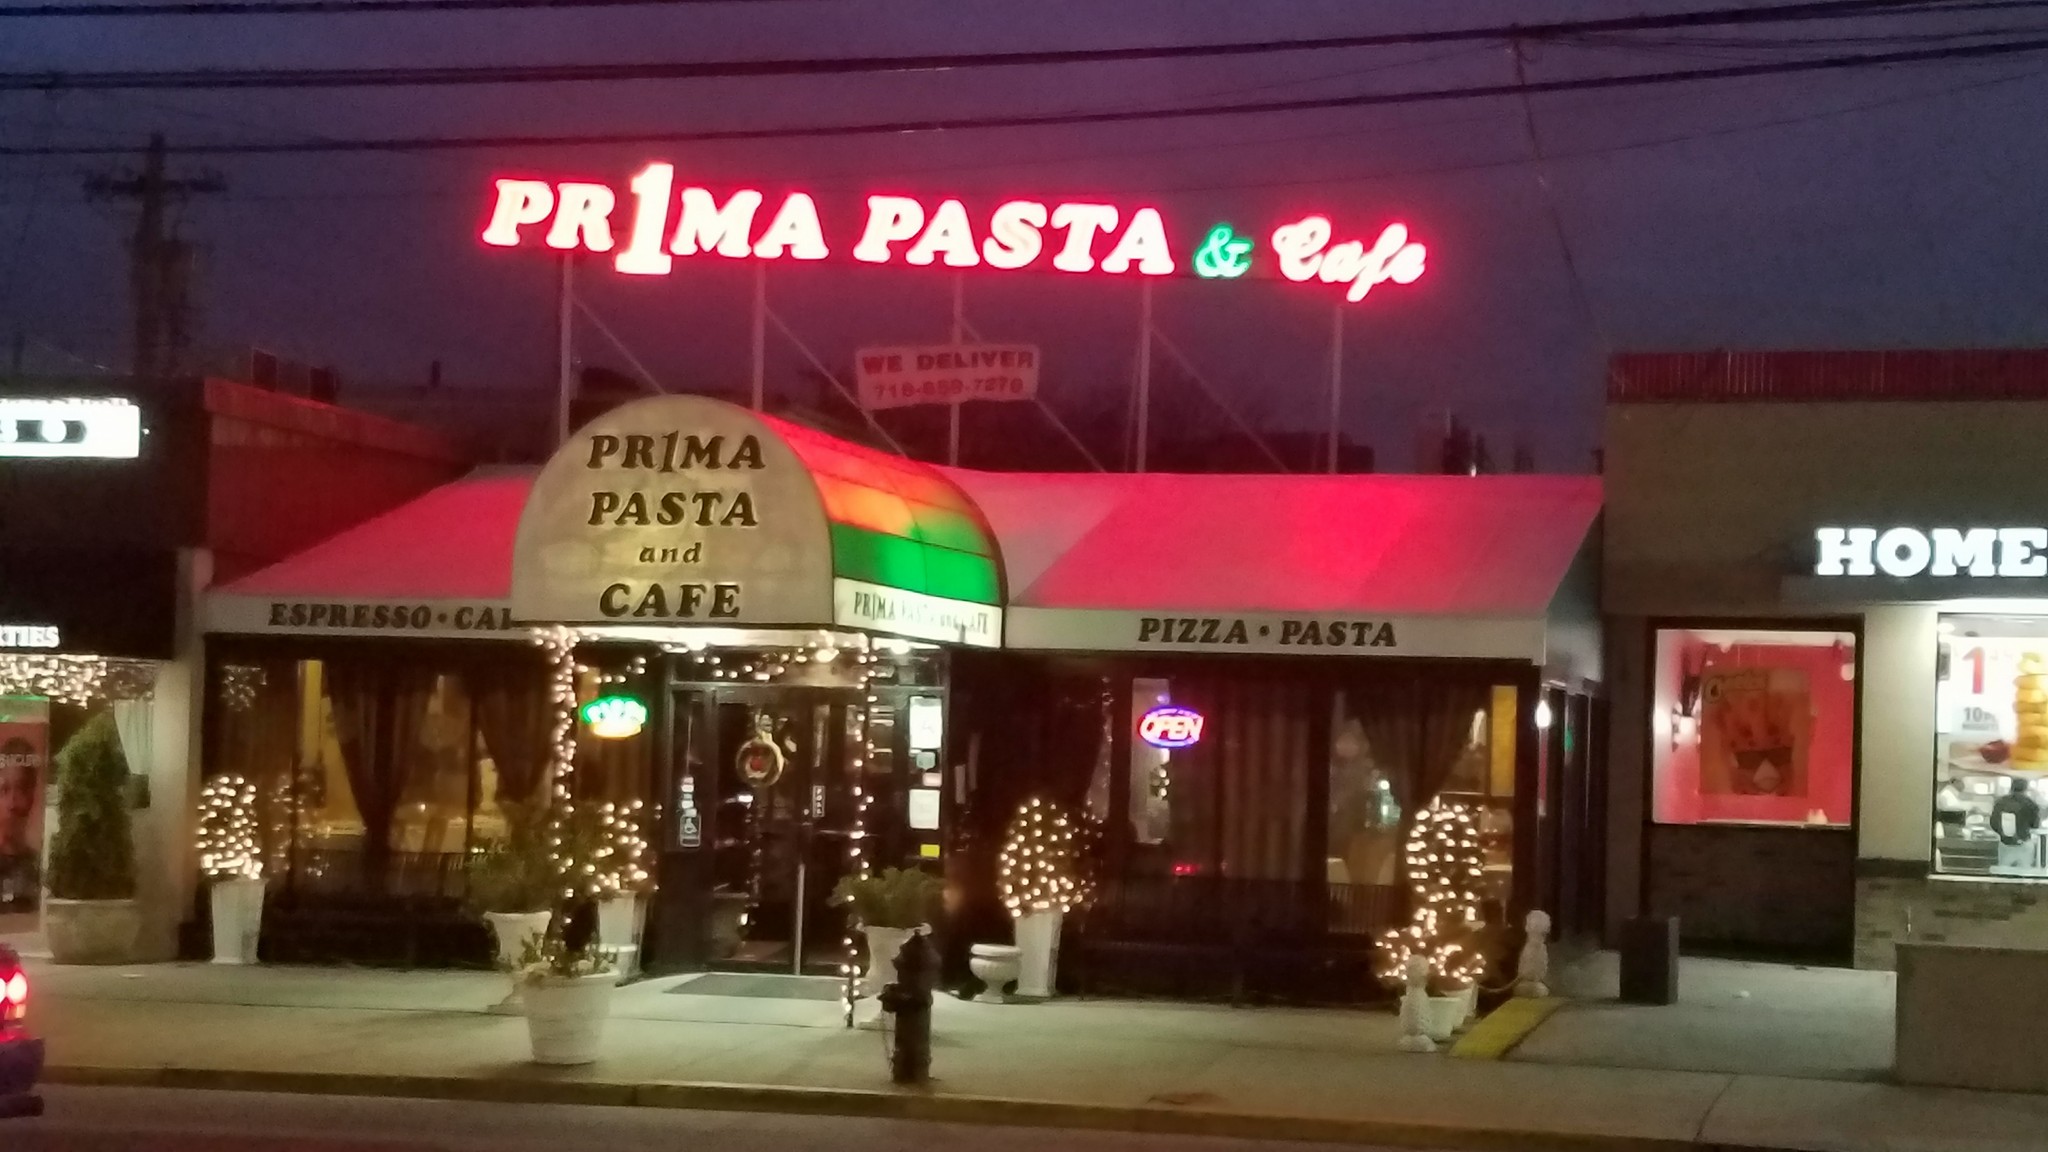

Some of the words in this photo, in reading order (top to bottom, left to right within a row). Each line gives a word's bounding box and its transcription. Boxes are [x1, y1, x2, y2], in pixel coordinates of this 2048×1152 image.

[853, 195, 1175, 275] PASTA
[1194, 223, 1252, 278] &
[1271, 216, 1427, 302] Cafe
[863, 355, 902, 375] WE
[917, 351, 1034, 371] DELIVER
[588, 491, 758, 527] PASTA
[638, 541, 702, 564] and
[1815, 527, 2048, 577] HOME
[599, 583, 741, 618] CAFE
[268, 603, 432, 629] ESPRESSO
[1138, 618, 1249, 644] PIZZA
[1279, 620, 1397, 647] PASTA
[1140, 715, 1205, 743] OPEN
